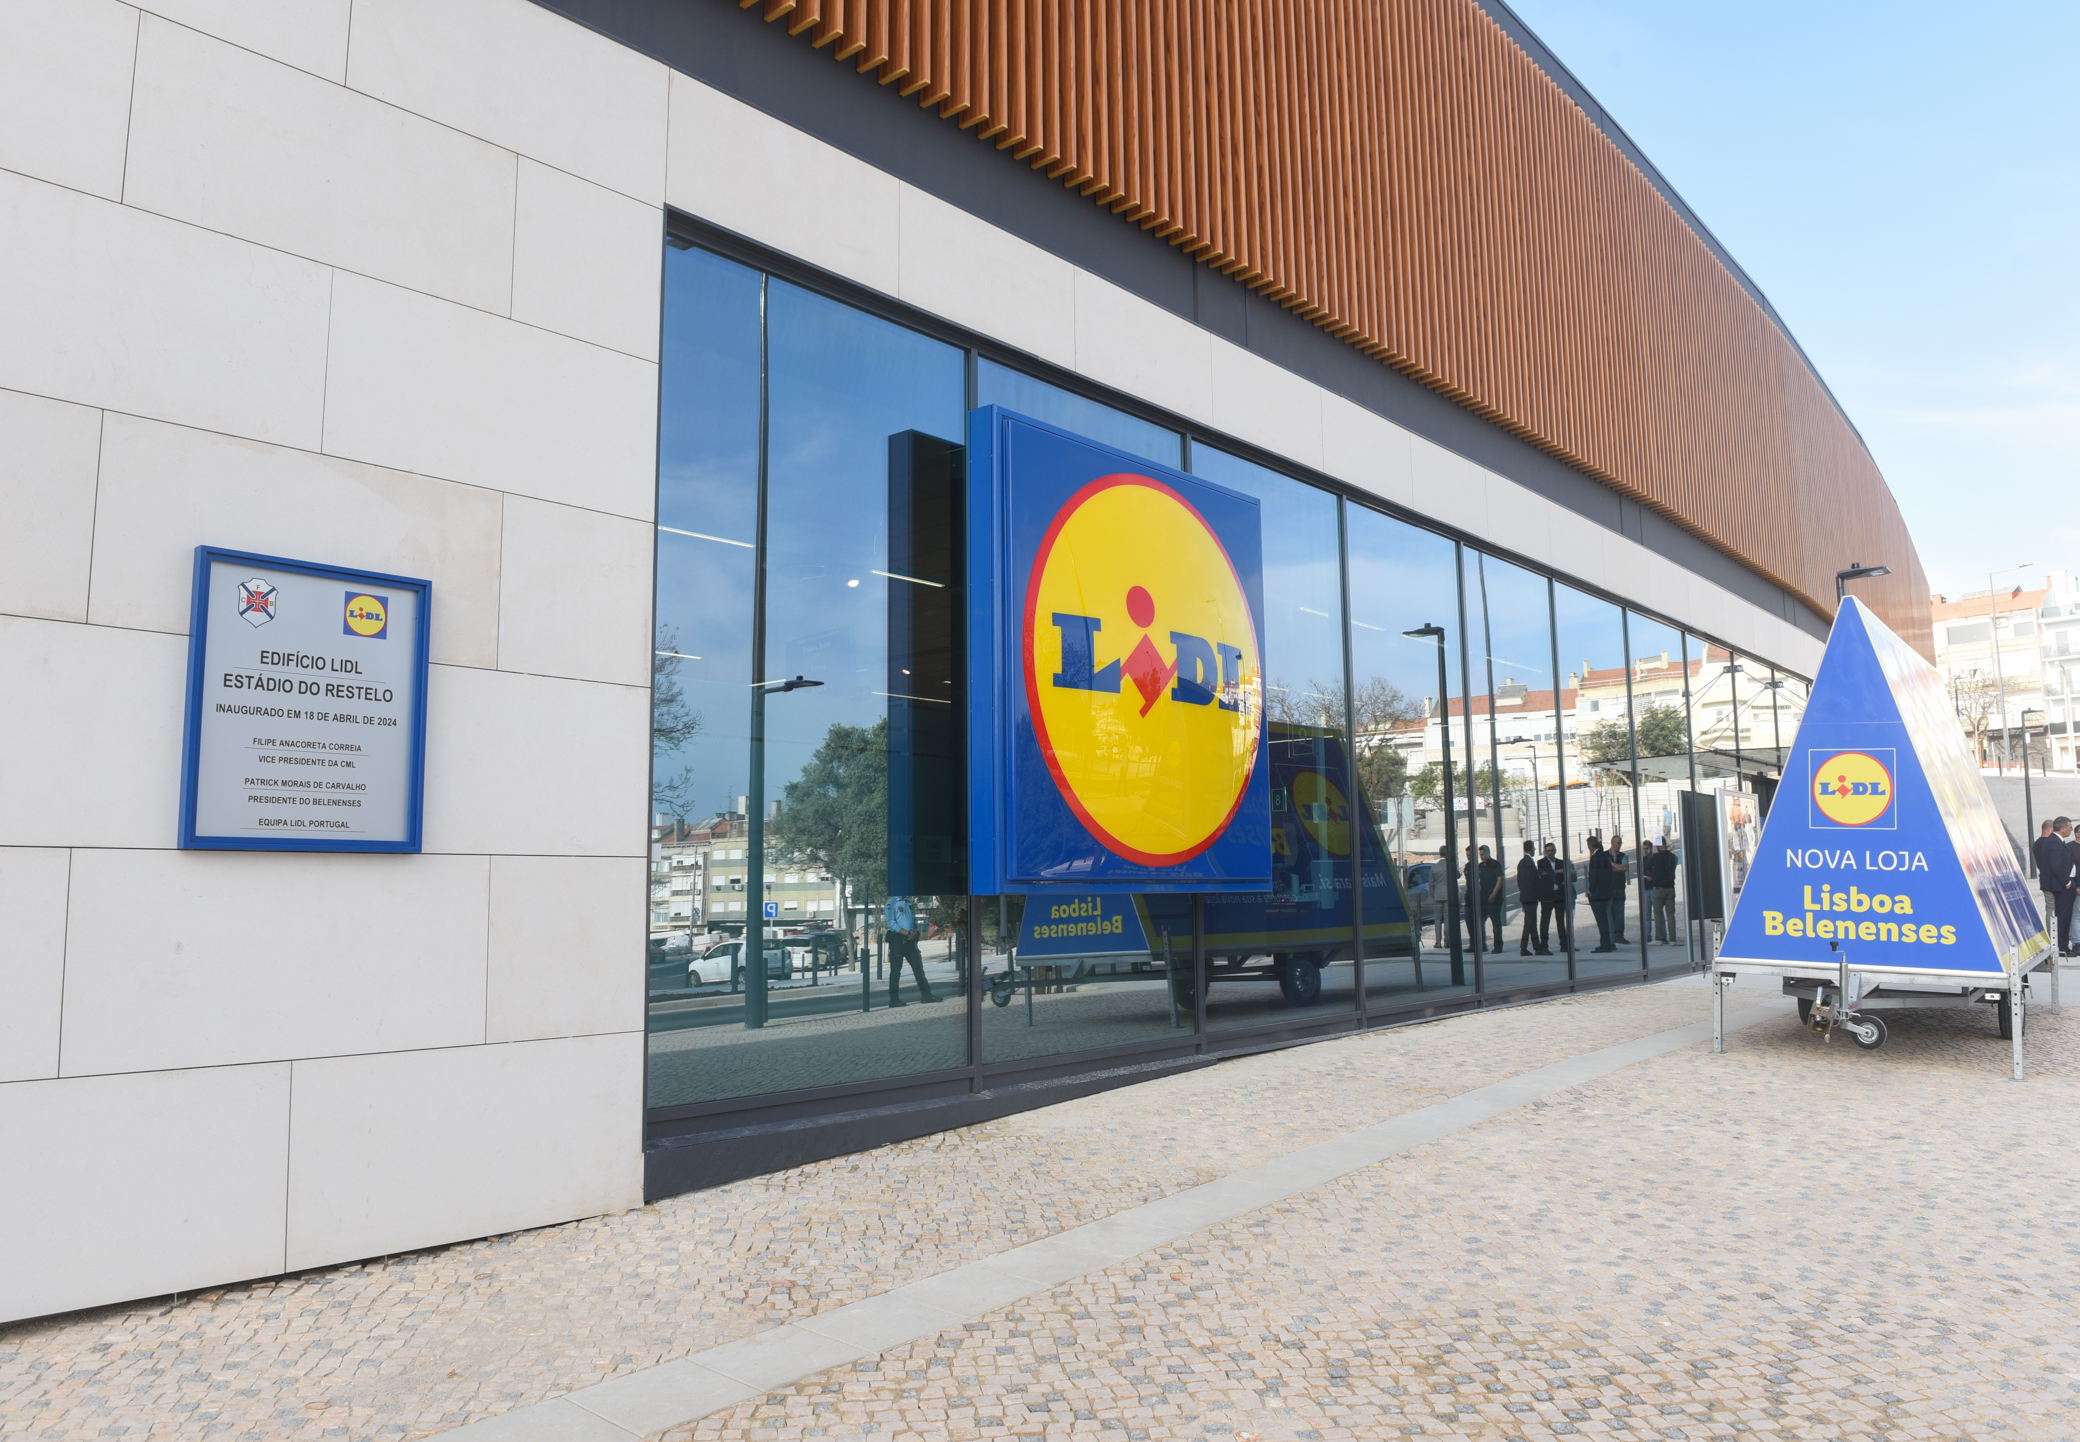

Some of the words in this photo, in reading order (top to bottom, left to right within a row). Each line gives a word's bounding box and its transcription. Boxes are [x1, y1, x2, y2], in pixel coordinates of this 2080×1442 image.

[260, 650, 326, 671] EDIFÍCIO
[330, 658, 363, 675] LIDL
[223, 672, 294, 694] ESTÁDIO
[298, 680, 321, 696] DO
[325, 683, 394, 703] RESTELO
[215, 703, 285, 718] INAUGURADO
[287, 709, 301, 719] EM
[304, 710, 315, 721] 18
[317, 711, 330, 722] DE
[332, 713, 360, 725] ABRIL
[362, 716, 375, 726] DE
[377, 717, 397, 727] 2024
[252, 737, 277, 747] FILIPE
[278, 739, 327, 750] ANACORETA
[328, 742, 362, 752] CORREIA
[258, 755, 276, 764] VICE
[278, 756, 326, 767] PRESIDENTE
[328, 759, 339, 768] DA
[340, 760, 356, 769] CML
[244, 777, 279, 787] PATRICK
[281, 779, 311, 789] MORAIS
[313, 781, 323, 789] DE
[325, 782, 366, 791] CARVALHO
[248, 795, 297, 805] PRESIDENTE
[299, 797, 311, 806] DO
[312, 798, 361, 808] BELENENSES
[1275, 794, 1281, 806] 8
[258, 818, 288, 827] EQUIPA
[290, 819, 307, 828] LIDL
[308, 820, 350, 829] PORTUGAL
[1786, 848, 1858, 871] NOVA
[1865, 850, 1929, 872] LOJA
[1803, 884, 1914, 915] Lisboa
[1763, 911, 1957, 946] Belenenses
